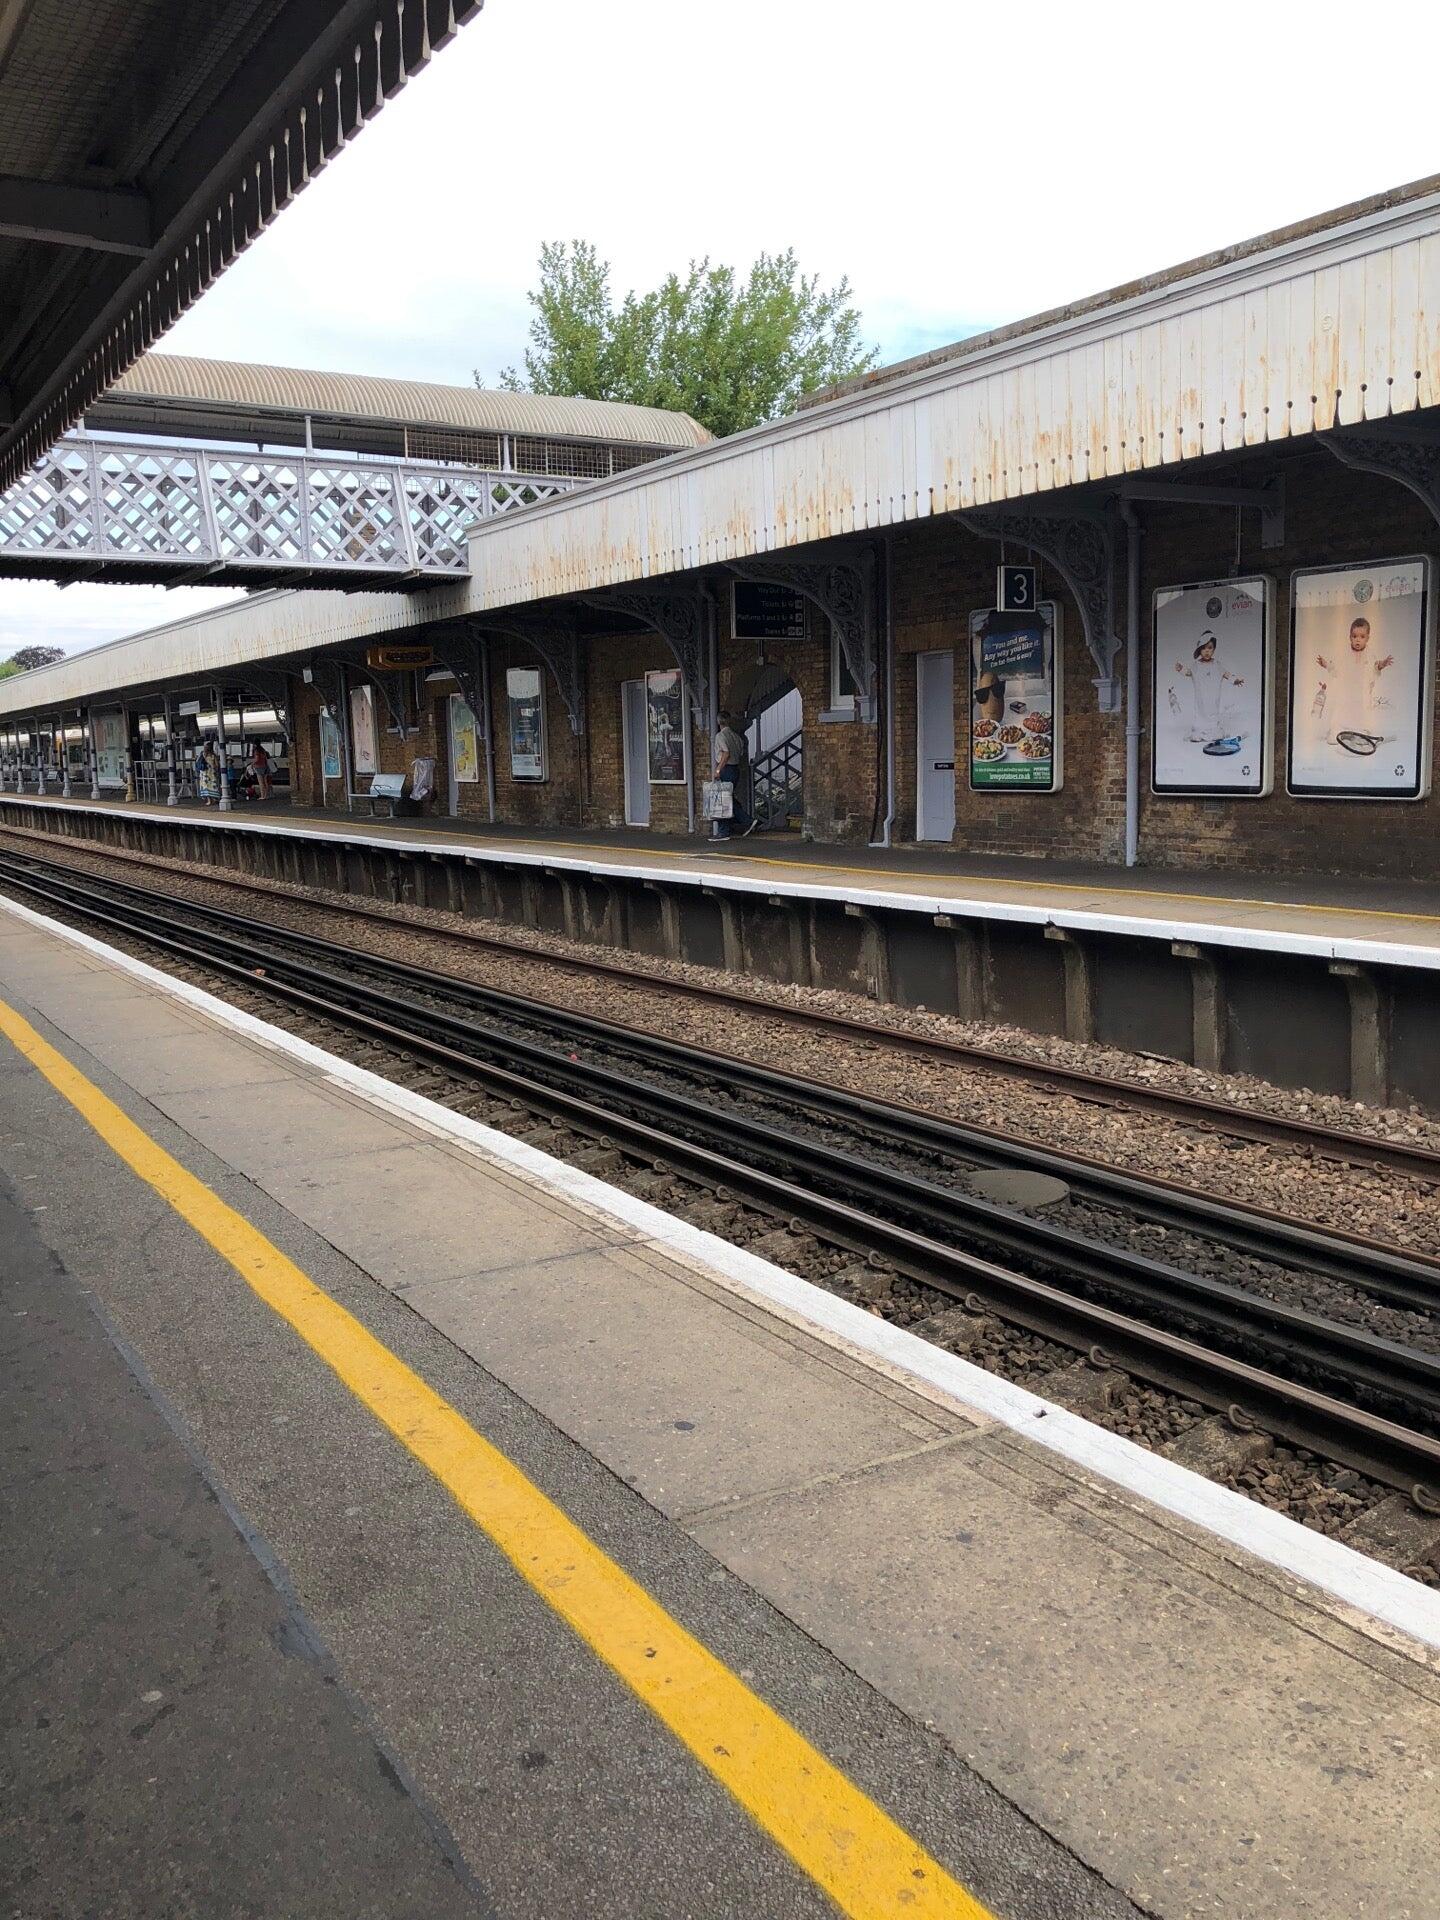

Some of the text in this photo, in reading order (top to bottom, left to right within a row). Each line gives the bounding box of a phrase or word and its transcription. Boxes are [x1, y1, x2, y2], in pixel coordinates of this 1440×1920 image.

[1013, 573, 1028, 604] 3
[984, 652, 996, 661] Any
[997, 648, 1010, 658] way
[1010, 645, 1022, 656] you
[1022, 641, 1034, 651] like
[1006, 636, 1018, 647] and
